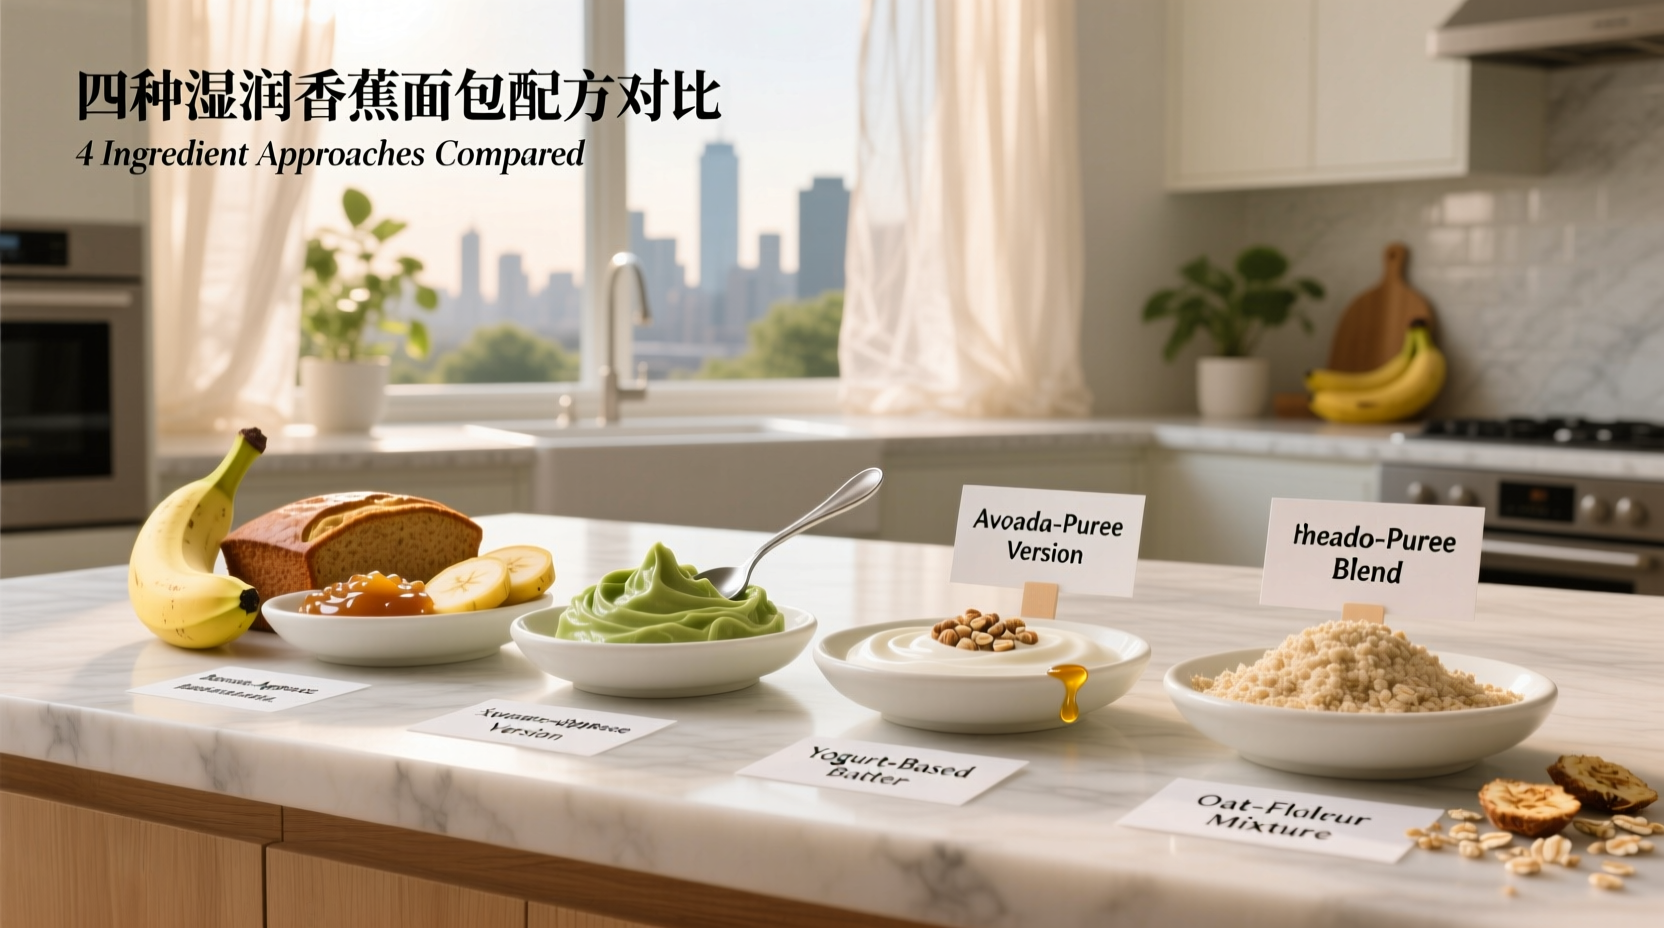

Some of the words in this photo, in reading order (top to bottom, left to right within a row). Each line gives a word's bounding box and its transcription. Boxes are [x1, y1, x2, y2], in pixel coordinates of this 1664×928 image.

[972, 507, 1124, 538] Avoada-Puree
[1007, 540, 1083, 565] Version
[1331, 556, 1404, 584] Blend
[809, 746, 976, 778] Yogurt-Based
[1206, 814, 1332, 840] Mixture
